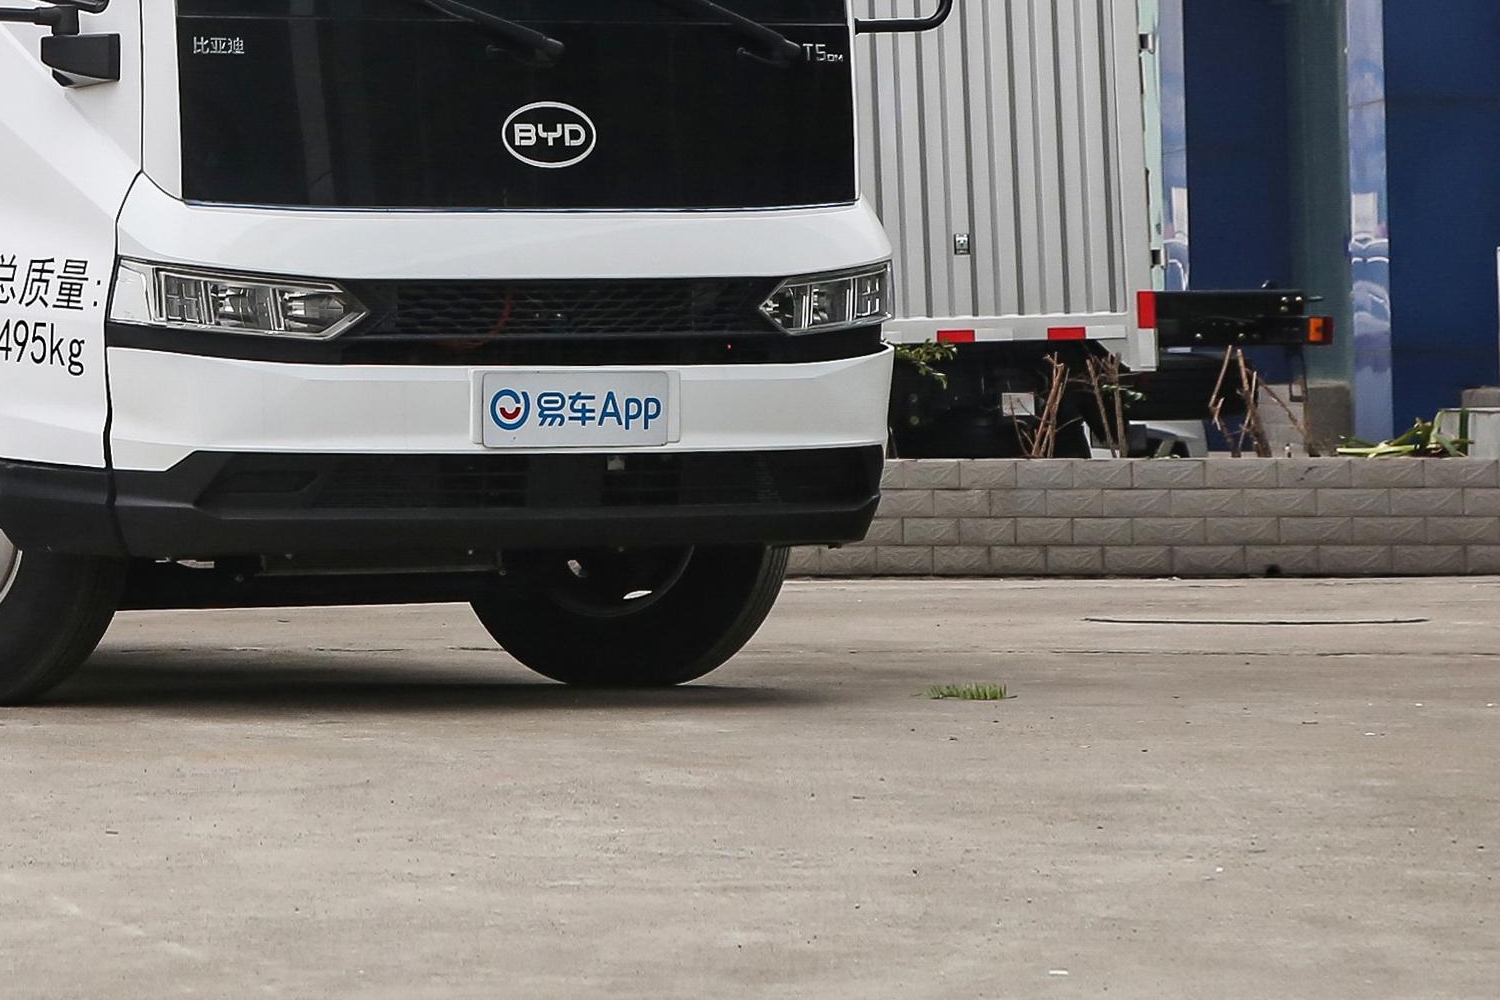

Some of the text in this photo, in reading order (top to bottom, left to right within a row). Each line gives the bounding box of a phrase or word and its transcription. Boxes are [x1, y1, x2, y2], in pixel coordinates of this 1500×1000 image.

[193, 36, 245, 54] 比亚迪
[513, 123, 587, 147] BYD
